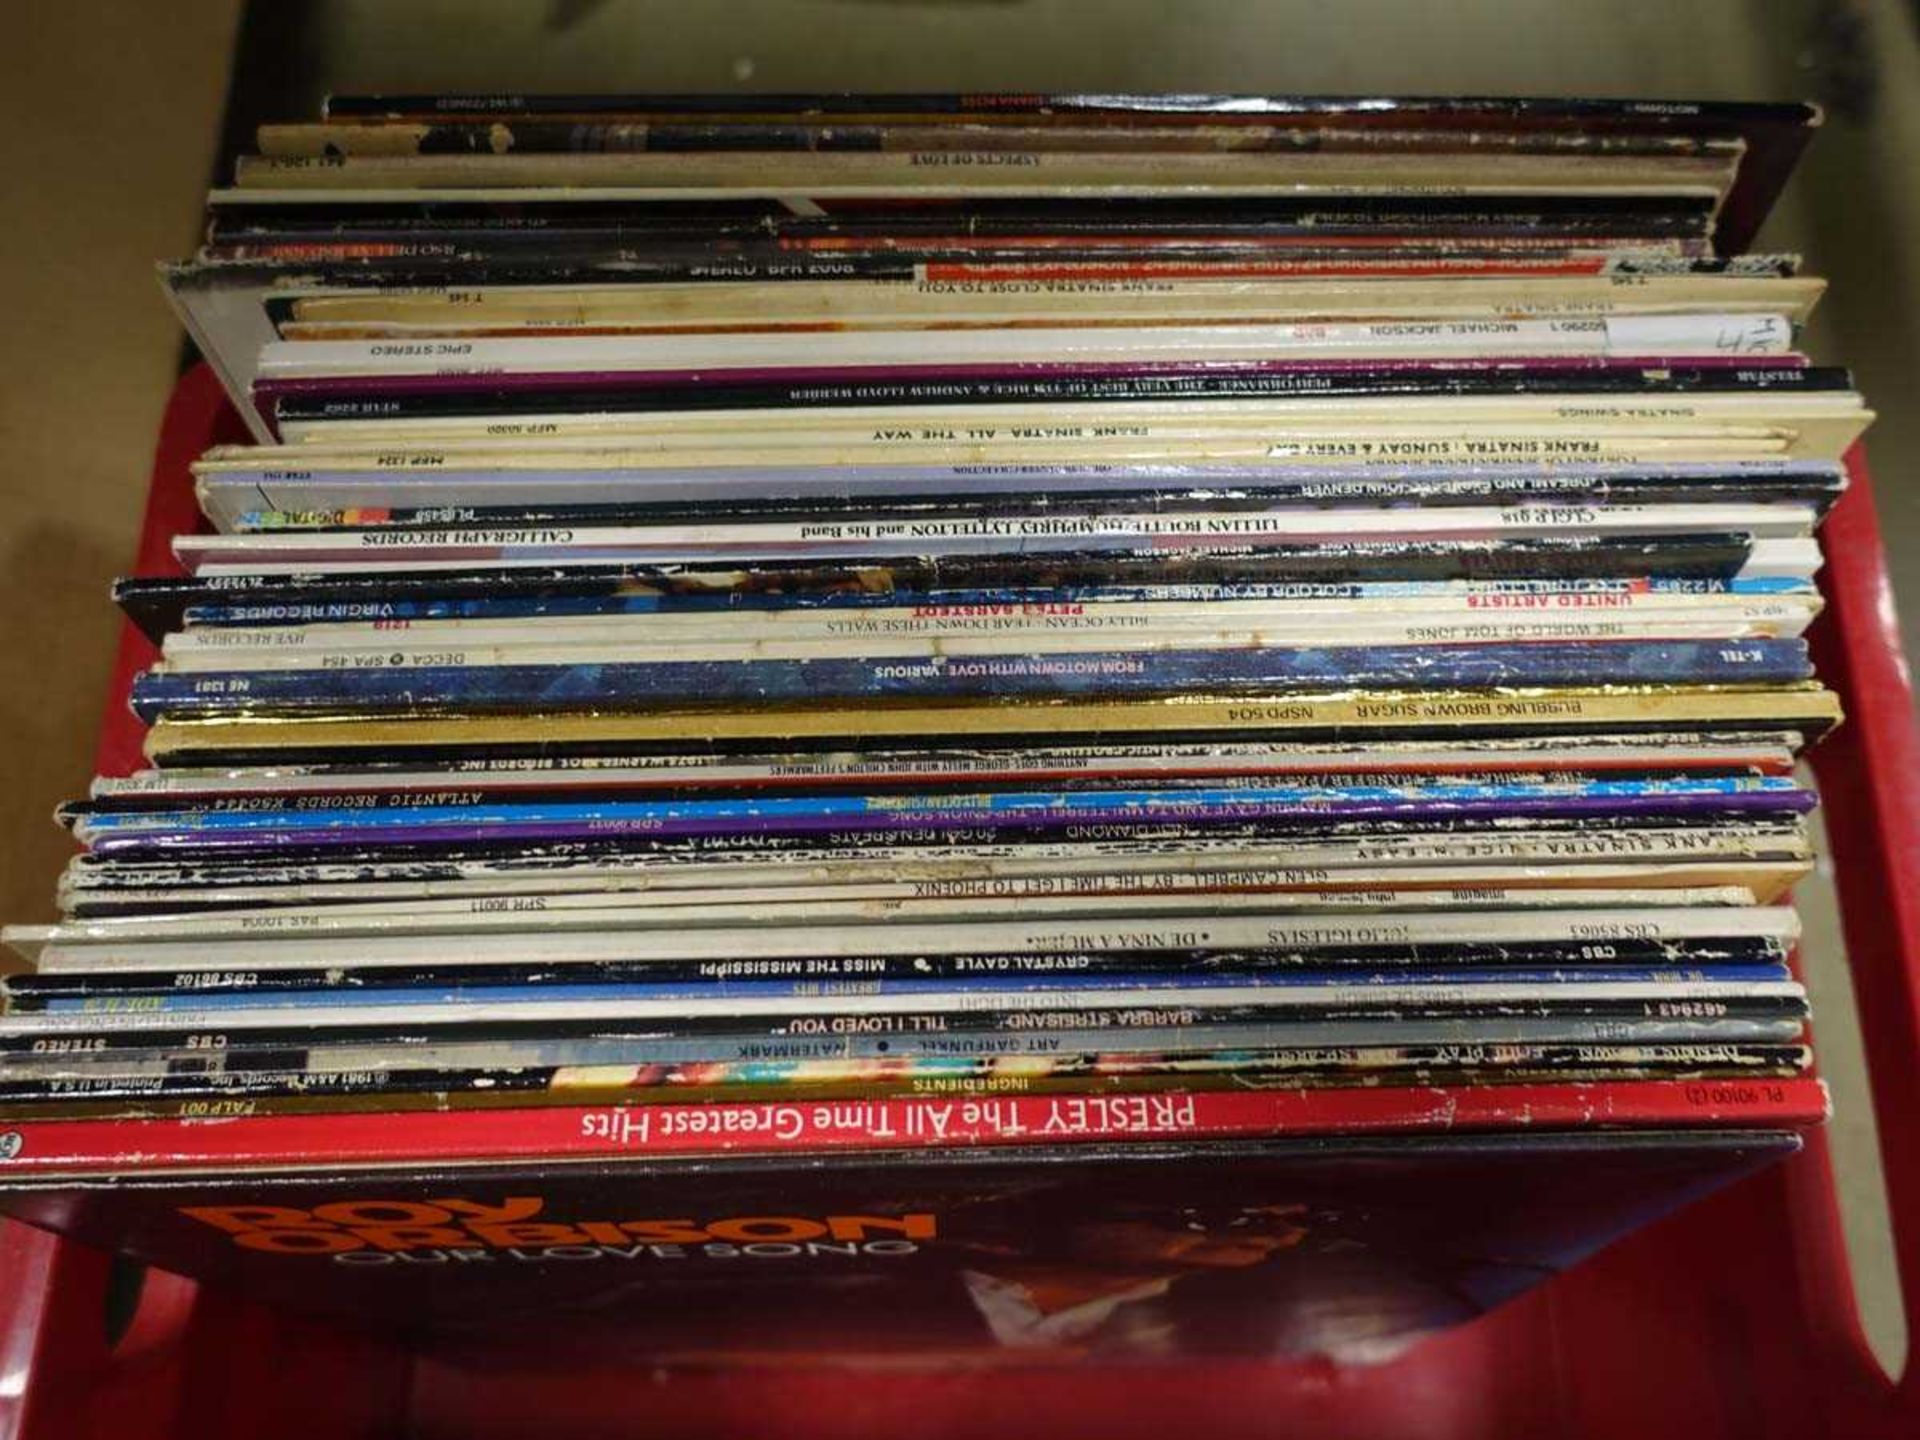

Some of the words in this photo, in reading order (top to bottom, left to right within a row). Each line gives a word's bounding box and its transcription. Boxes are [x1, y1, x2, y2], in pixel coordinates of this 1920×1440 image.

[1369, 324, 1442, 337] JACKSON
[1447, 322, 1519, 335] MICHAEL
[370, 345, 433, 357] STEREO
[437, 344, 473, 356] EPIC
[790, 387, 852, 400] WEBBER
[856, 386, 904, 398] LLOYD
[910, 384, 973, 397] ANDREW
[872, 430, 912, 441] WAY
[922, 430, 955, 440] THE
[967, 429, 996, 439] ALL
[1011, 427, 1083, 438] SINATRA
[1092, 426, 1149, 437] FRANK
[1305, 443, 1356, 455] EVERY
[1361, 443, 1373, 454] &
[1378, 442, 1450, 454] SUNDAY
[1465, 441, 1538, 454] SINATRA
[1543, 440, 1600, 453] FRANK
[282, 511, 345, 525] DIGITAL
[1205, 518, 1278, 532] LILLIAN
[800, 526, 842, 539] Band
[846, 525, 871, 538] his
[875, 525, 906, 538] and
[911, 522, 1012, 536] LYTTELTON
[361, 532, 449, 547] RECORDS
[453, 529, 574, 544] CALLIGRAPH
[1467, 595, 1548, 608] ARTISTS
[1558, 594, 1632, 607] UNITED
[232, 604, 325, 619] RECORDS
[328, 603, 395, 617] VIRGIN
[826, 621, 879, 633] WALLS
[881, 620, 932, 632] THESE
[935, 619, 988, 631] DOWN
[1045, 617, 1104, 629] OCEAN
[1504, 624, 1526, 635] OF
[1531, 624, 1591, 635] WORLD
[1595, 623, 1625, 634] THE
[1406, 626, 1459, 640] JONES
[1465, 625, 1500, 636] TOM
[322, 655, 348, 668] 454
[354, 654, 385, 667] SPA
[412, 653, 466, 666] DECCA
[1718, 649, 1764, 663] K-TEL
[874, 665, 940, 678] VARIOUS
[948, 664, 987, 677] LOVE
[987, 663, 1027, 675] WITH
[1028, 662, 1100, 675] MOTOWN
[1100, 661, 1145, 674] FROM
[1227, 708, 1262, 721] 504
[1266, 706, 1314, 720] NSPD
[1356, 704, 1419, 719] SUGAR
[1424, 703, 1491, 717] BROWN
[1496, 701, 1582, 716] BUBBLING
[1040, 758, 1089, 769] ANYTHING
[295, 794, 379, 809] RECORDS
[388, 791, 483, 806] ATLANTIC
[1066, 825, 1150, 839] DIAMOND
[1356, 846, 1416, 861] EASY
[1546, 839, 1652, 857] SINATRA
[1065, 876, 1105, 891] TIME
[1112, 875, 1144, 889] THE
[1189, 871, 1279, 886] CAMPBELL
[1282, 870, 1328, 883] GLEN
[913, 882, 987, 898] PHOENIX
[990, 880, 1016, 894] TO
[1021, 879, 1055, 893] GET
[512, 898, 547, 911] SPR
[1267, 929, 1352, 945] IGLESIAS
[1624, 923, 1661, 938] CBS
[1101, 934, 1116, 948] A
[1169, 933, 1196, 946] DE
[1582, 946, 1617, 959] CBS
[699, 961, 802, 977] MISSISSIPPI
[806, 960, 839, 974] THE
[842, 958, 886, 972] MISS
[954, 957, 1009, 971] GAYLE
[1013, 955, 1089, 970] CRYSTAL
[906, 1016, 948, 1031] TILL
[1006, 1012, 1110, 1028] STREISAND
[1114, 1009, 1194, 1025] BARBRA
[789, 1020, 827, 1035] YOU
[831, 1018, 890, 1034] LOVED
[32, 1038, 106, 1054] STEREO
[186, 1034, 228, 1049] CBS
[918, 1039, 1022, 1054] GARFUNKEL
[1027, 1039, 1060, 1052] ART
[737, 1043, 846, 1058] WATERMARK
[94, 1078, 112, 1091] in
[113, 1077, 165, 1091] Printed
[304, 1072, 339, 1086] A&M
[341, 1072, 373, 1085] 1981
[912, 1077, 1029, 1093] INGREDIENTS
[1685, 1086, 1710, 1106] (2)
[1712, 1088, 1760, 1105] 90100
[1766, 1087, 1784, 1104] PL
[179, 1101, 209, 1116] 001
[1043, 1095, 1196, 1132] PRESLEY
[660, 1105, 804, 1142] Greatest
[813, 1104, 897, 1139] Time
[906, 1103, 954, 1139] All
[961, 1100, 1028, 1137] The
[581, 1108, 650, 1145] Hits
[177, 1197, 545, 1232] ROY
[232, 1213, 938, 1254] ORBISON
[333, 1244, 496, 1266] OUR
[514, 1241, 688, 1261] LOVE
[705, 1237, 921, 1258] SONG
